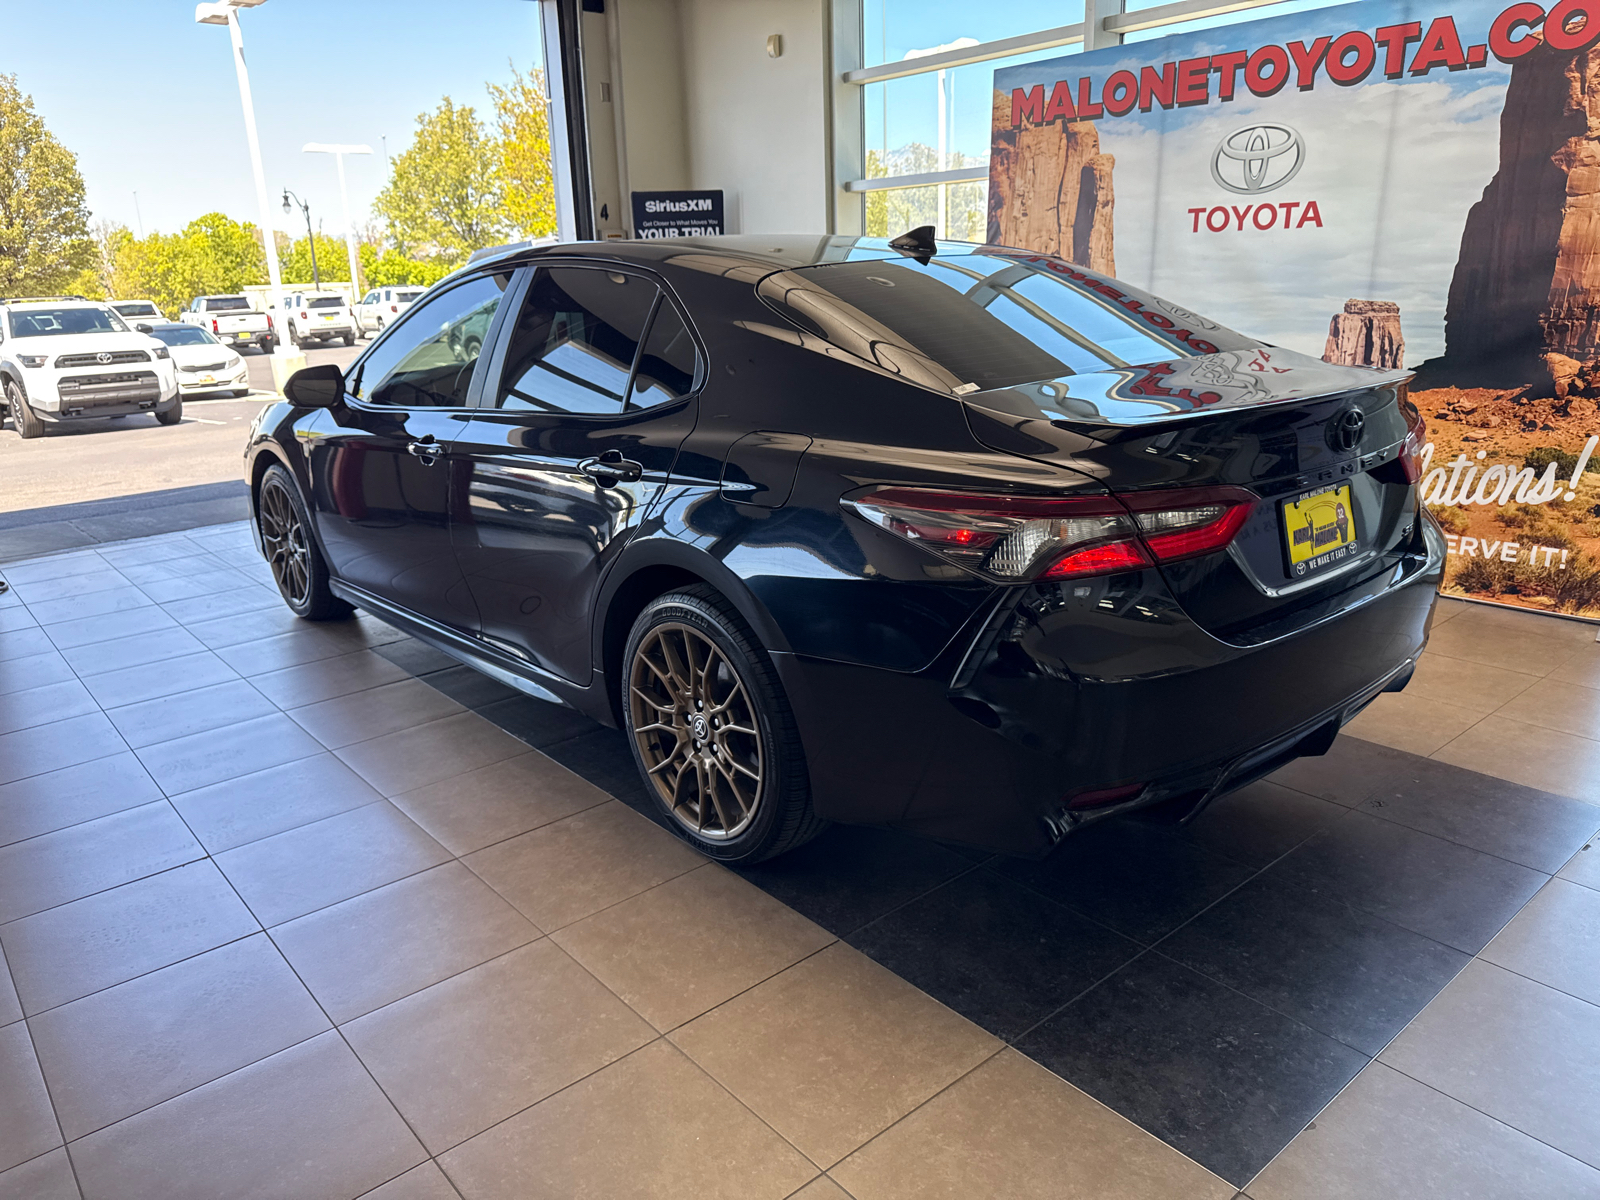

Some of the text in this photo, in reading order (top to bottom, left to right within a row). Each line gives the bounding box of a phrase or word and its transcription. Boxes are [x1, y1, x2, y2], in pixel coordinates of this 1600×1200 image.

[600, 203, 609, 221] 4
[645, 199, 713, 213] SiriusXM
[1187, 201, 1323, 233] TOYOTA
[638, 227, 679, 239] YOUR
[1337, 508, 1345, 519] 32
[1309, 547, 1347, 569] WE MAKE IT EASY
[1529, 545, 1568, 569] IT!
[661, 607, 708, 628] GOODYEAR
